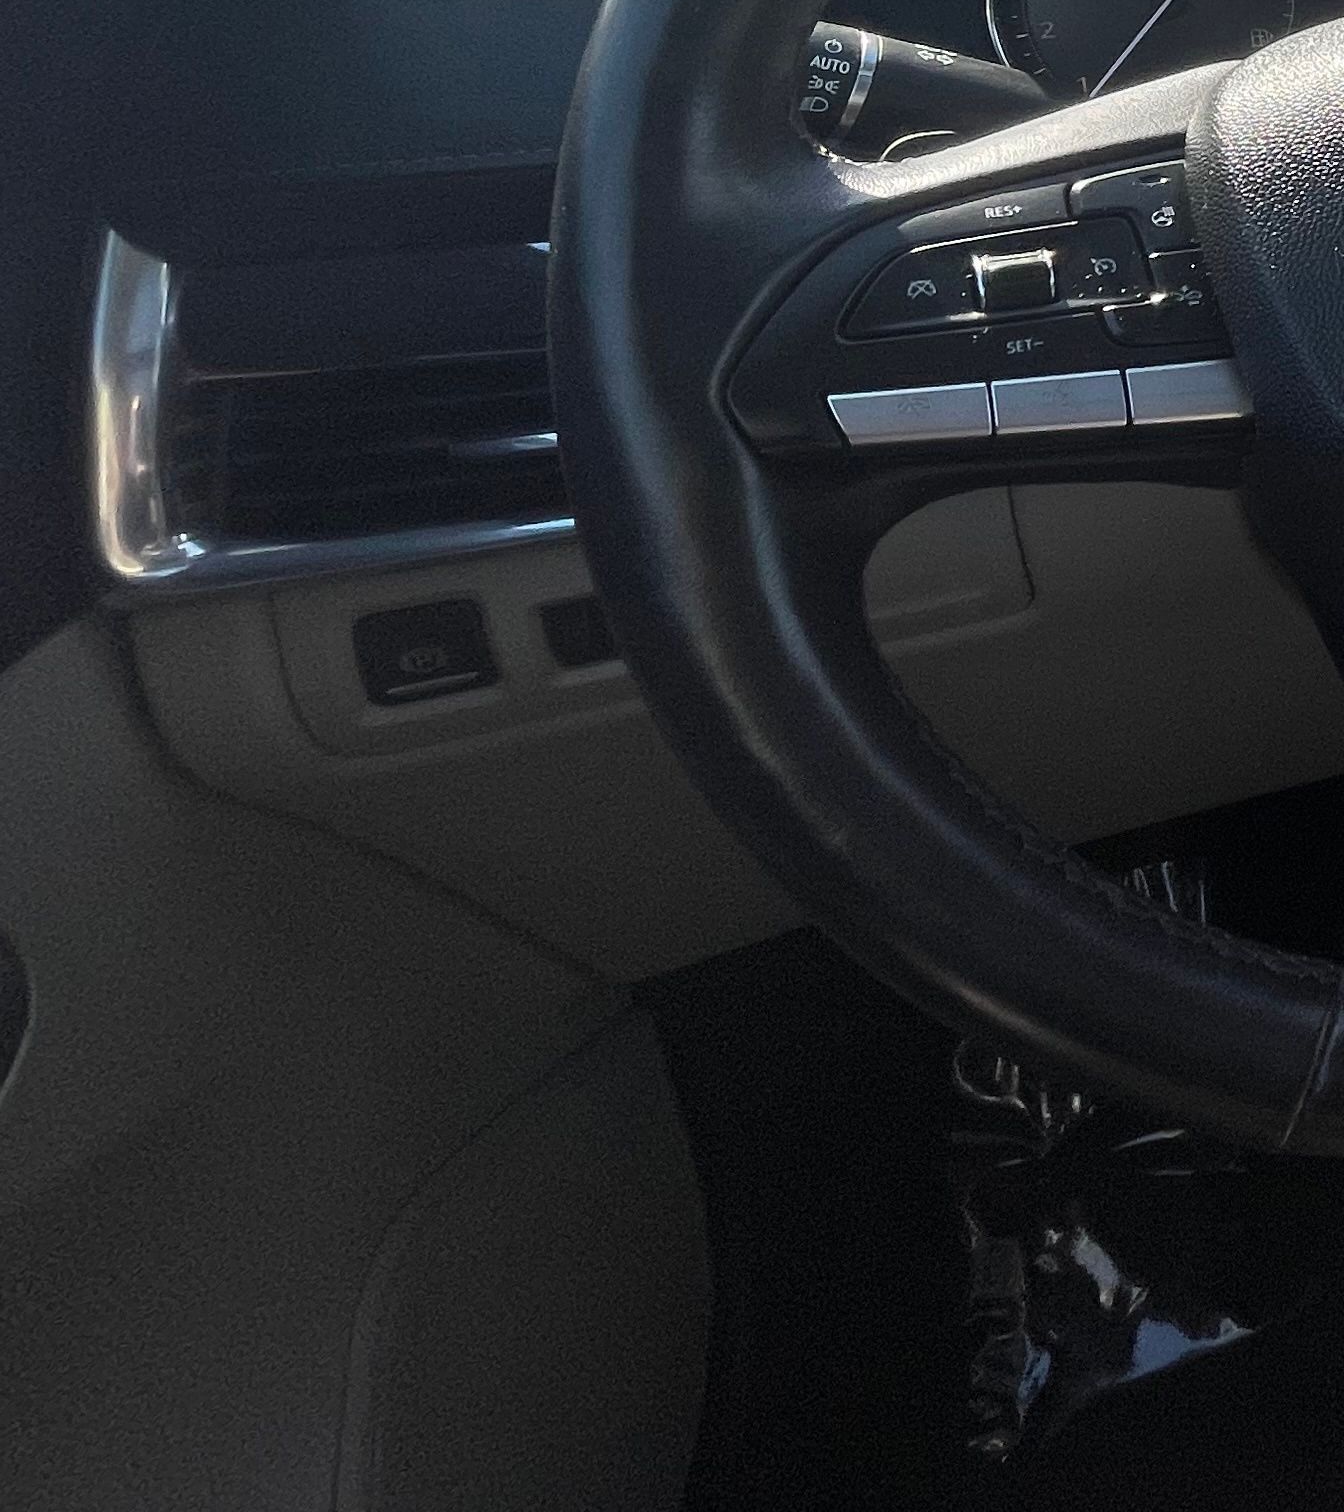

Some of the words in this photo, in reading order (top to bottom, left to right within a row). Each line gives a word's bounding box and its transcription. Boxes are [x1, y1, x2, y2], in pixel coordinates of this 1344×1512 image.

[1040, 22, 1057, 39] 2
[809, 55, 850, 75] AUTO
[984, 205, 1023, 220] RES+
